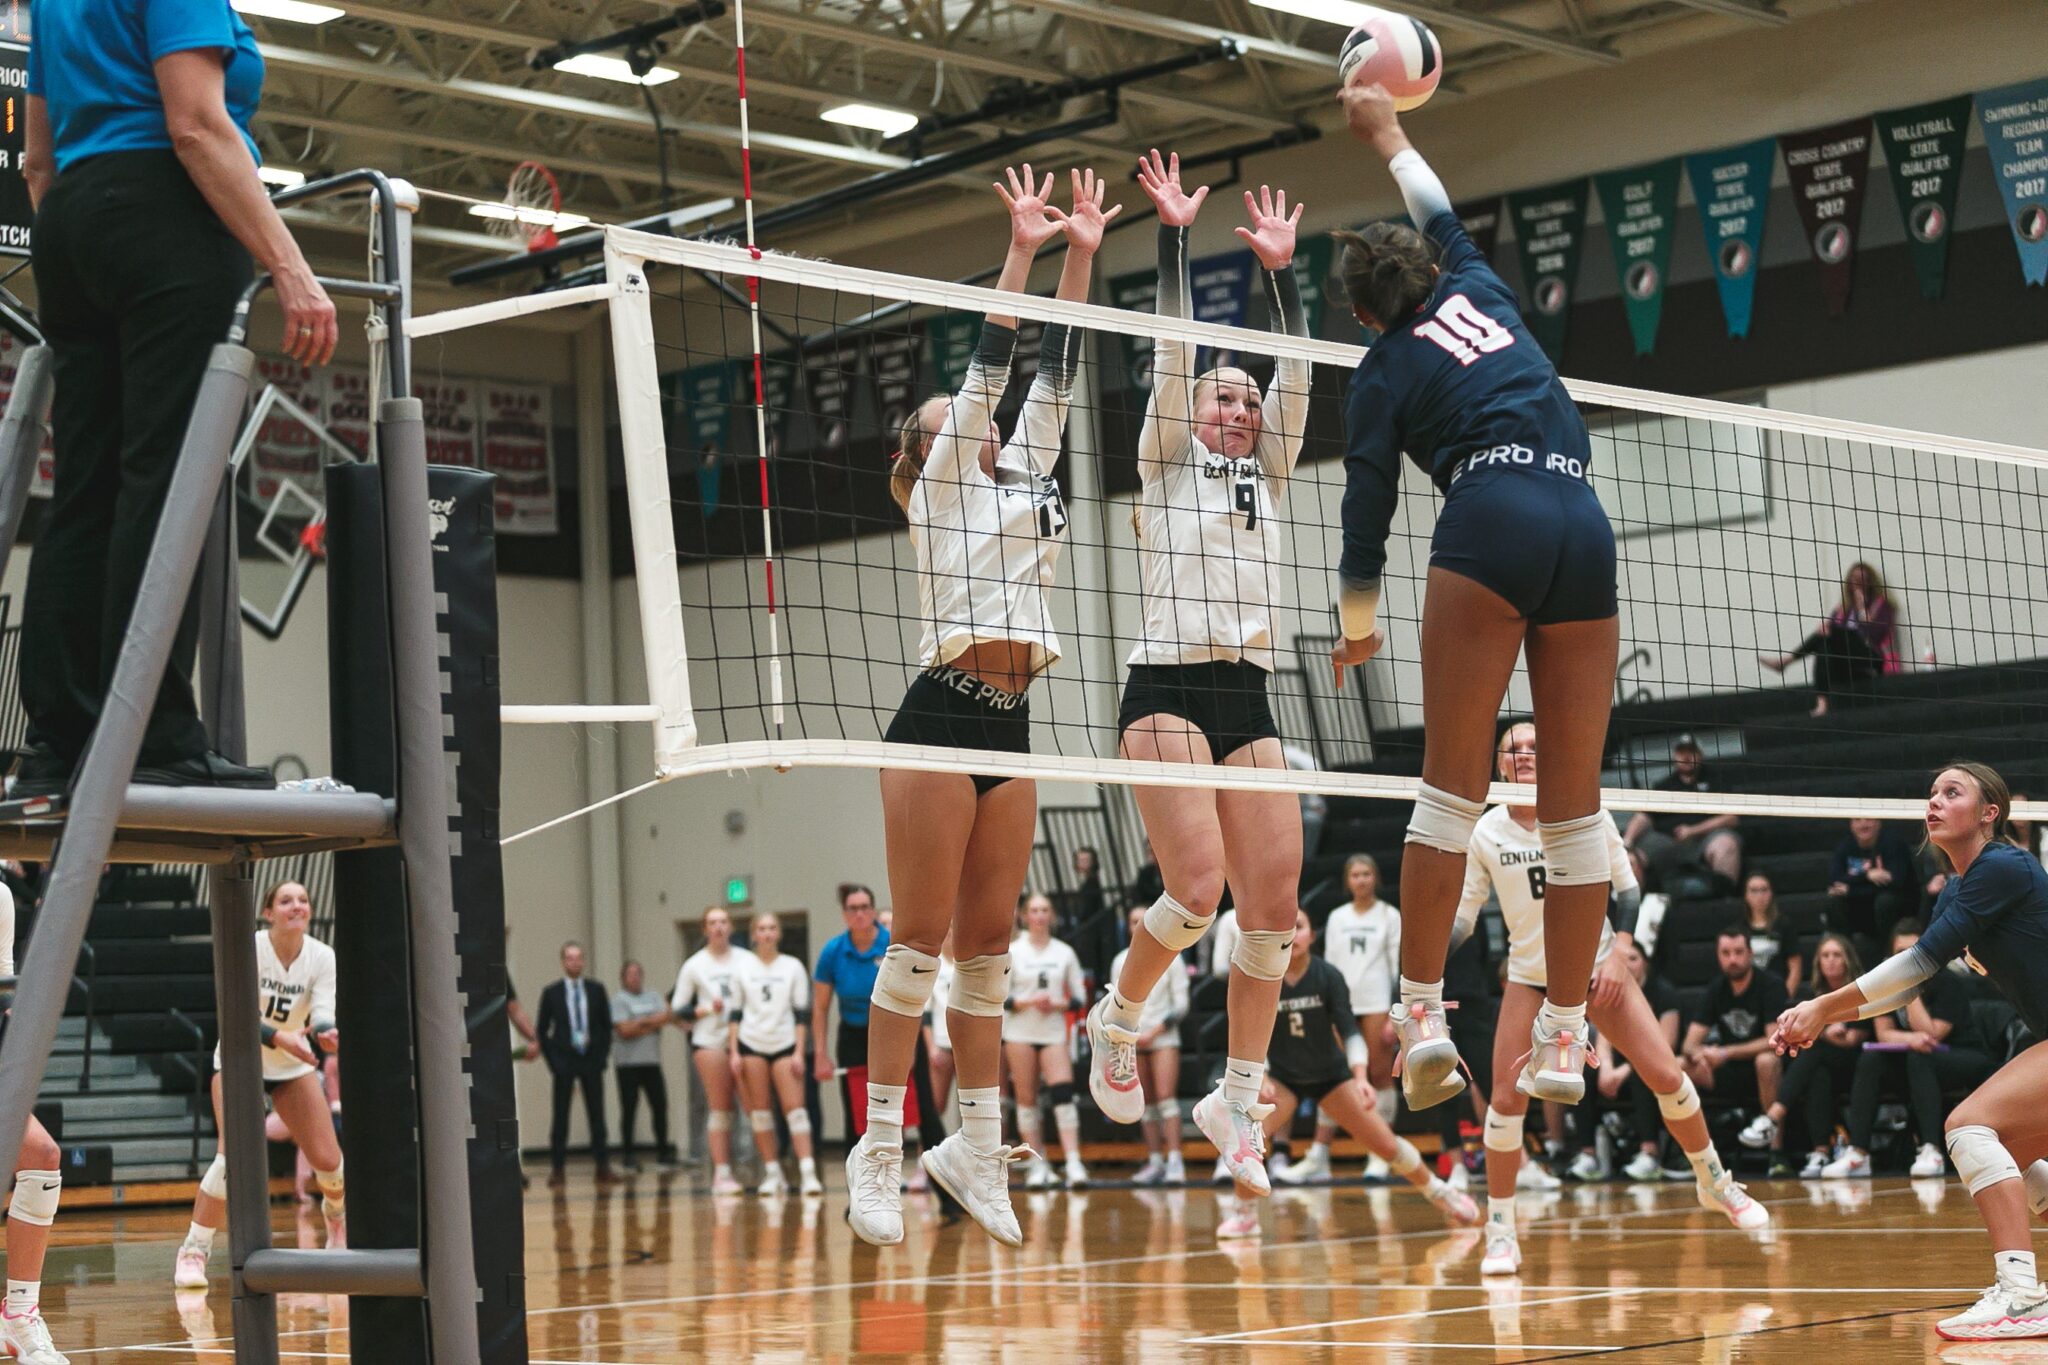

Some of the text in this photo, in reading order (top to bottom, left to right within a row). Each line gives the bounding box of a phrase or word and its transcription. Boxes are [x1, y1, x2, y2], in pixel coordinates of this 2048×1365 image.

[1892, 117, 1955, 141] VOLLEYBALL
[1910, 139, 1940, 158] STATE
[2015, 139, 2043, 156] TEAM
[1900, 154, 1950, 177] QUALIFIER
[1911, 176, 1942, 197] 2017
[2016, 177, 2046, 198] 2017
[1816, 198, 1846, 219] 2017
[0, 225, 31, 246] TCH
[1413, 294, 1516, 368] 10
[1468, 443, 1534, 472] PRO
[1234, 483, 1257, 532] 9
[974, 684, 1019, 710] PRO
[1500, 850, 1546, 866] CENTEN
[265, 995, 292, 1023] 15
[1288, 1011, 1305, 1038] 2
